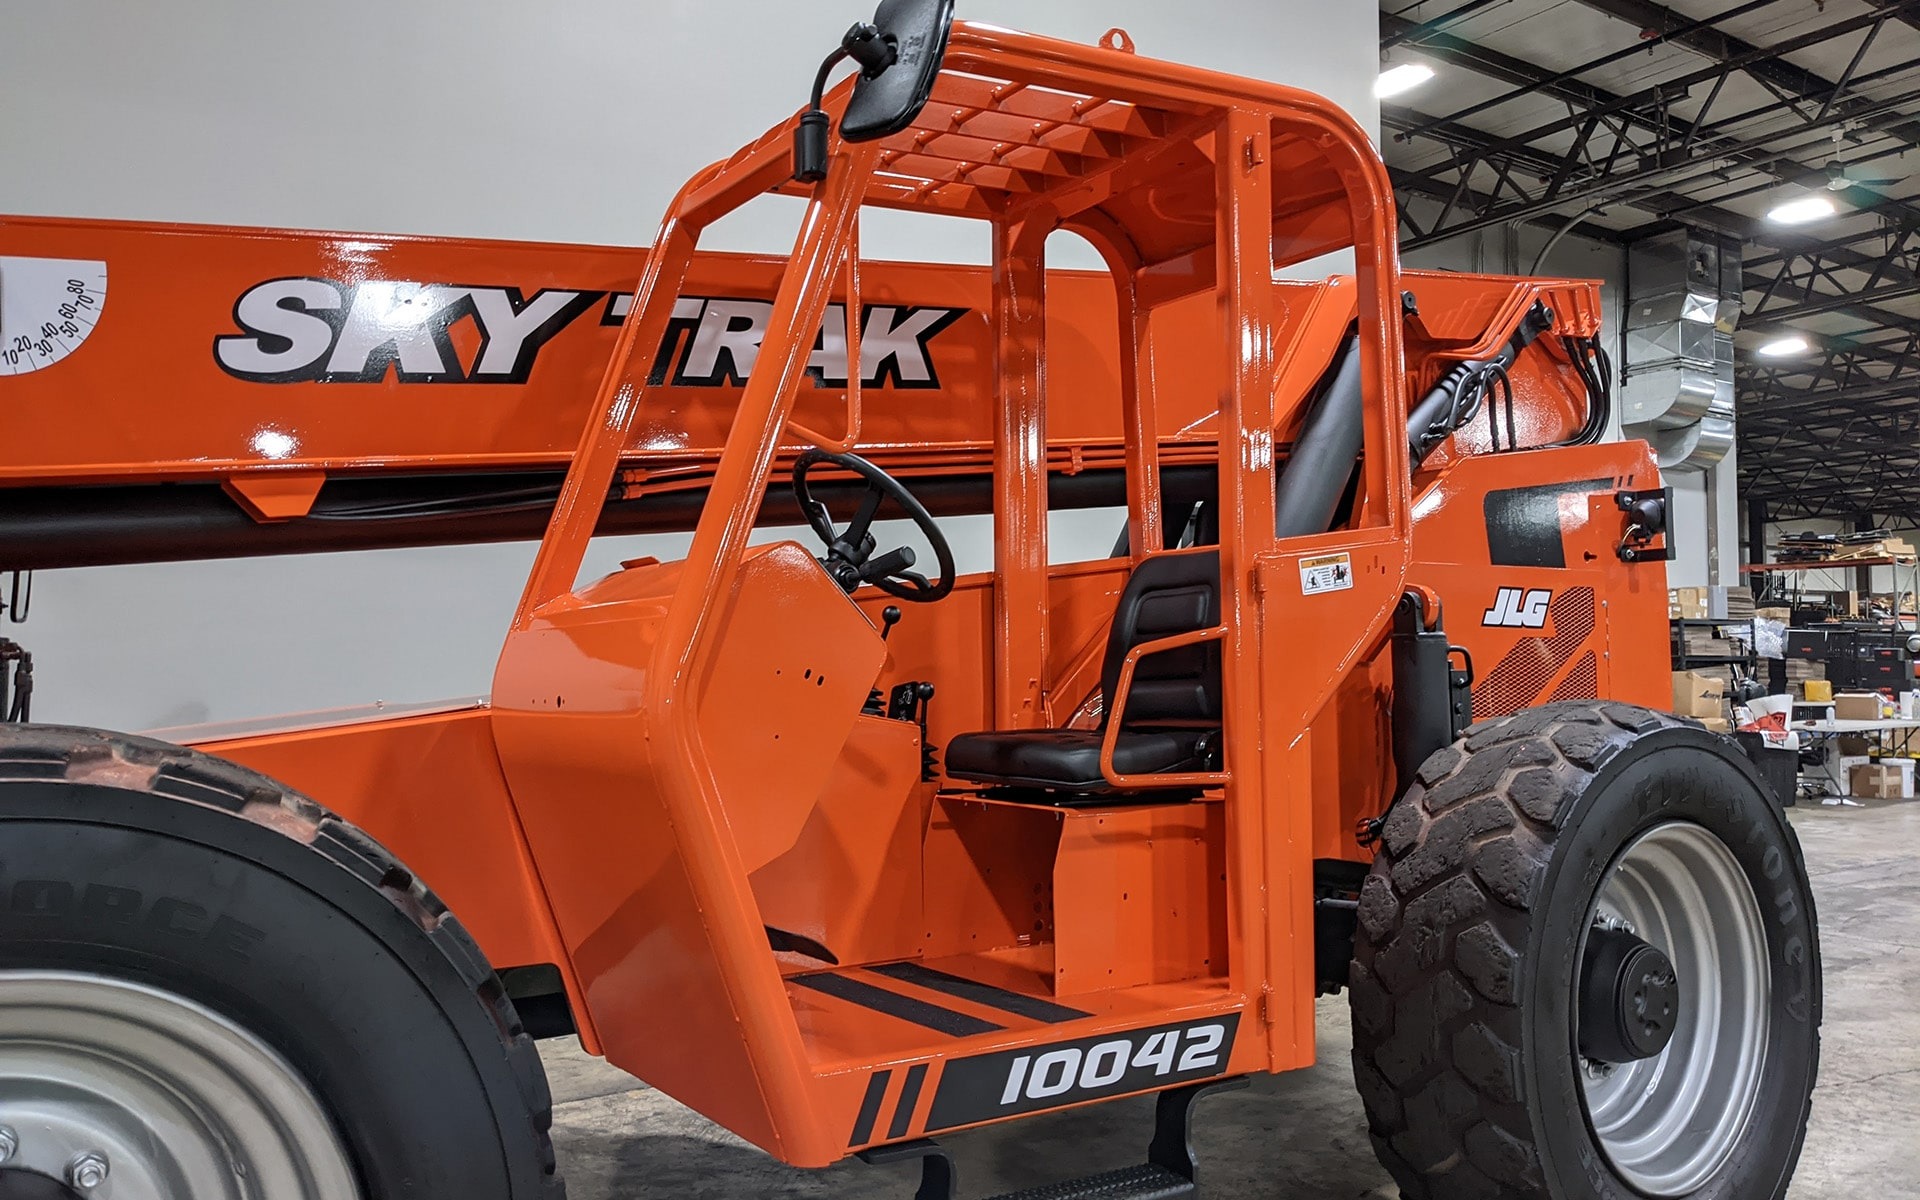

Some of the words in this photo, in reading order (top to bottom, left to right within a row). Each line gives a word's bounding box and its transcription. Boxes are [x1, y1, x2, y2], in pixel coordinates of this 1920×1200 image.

[66, 279, 85, 295] 80
[58, 302, 78, 320] 60
[74, 294, 95, 311] 70
[40, 322, 59, 340] 40
[59, 320, 79, 338] 50
[217, 278, 581, 375] SKY
[610, 294, 951, 381] RAK
[13, 335, 32, 353] 20
[33, 339, 54, 357] 30
[2, 349, 19, 366] 10
[1482, 587, 1552, 628] JLG
[1000, 1023, 1226, 1105] 10042
